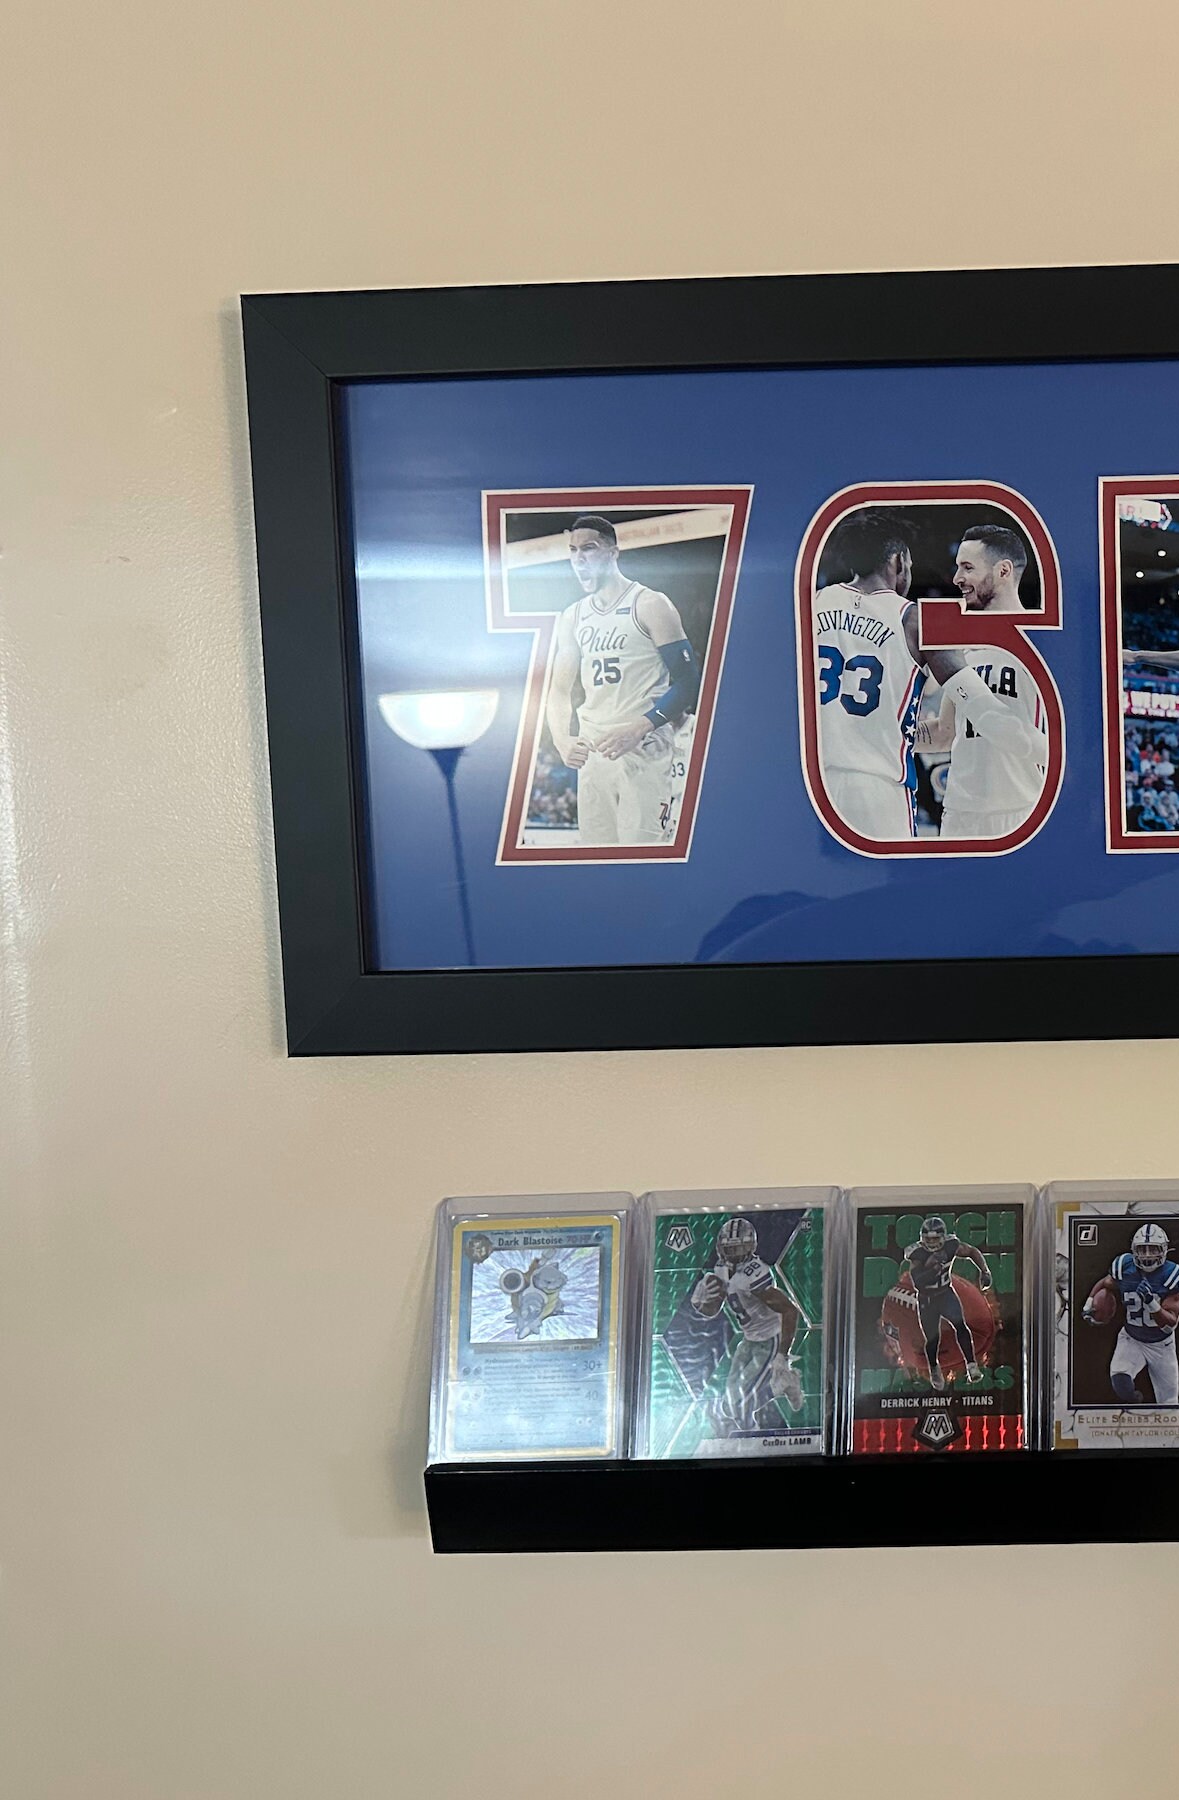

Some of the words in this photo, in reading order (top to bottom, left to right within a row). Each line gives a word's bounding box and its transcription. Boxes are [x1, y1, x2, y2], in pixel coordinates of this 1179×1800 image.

[579, 625, 628, 653] Phila
[817, 610, 894, 647] OVINGTON
[592, 657, 621, 686] 25
[818, 645, 884, 717] 33
[498, 1237, 519, 1247] Dark
[523, 1236, 563, 1246] Blastoise
[881, 1398, 920, 1409] DERRICK
[922, 1396, 952, 1407] HENRY
[962, 1395, 994, 1406] TITANS
[789, 1438, 812, 1446] LAMB
